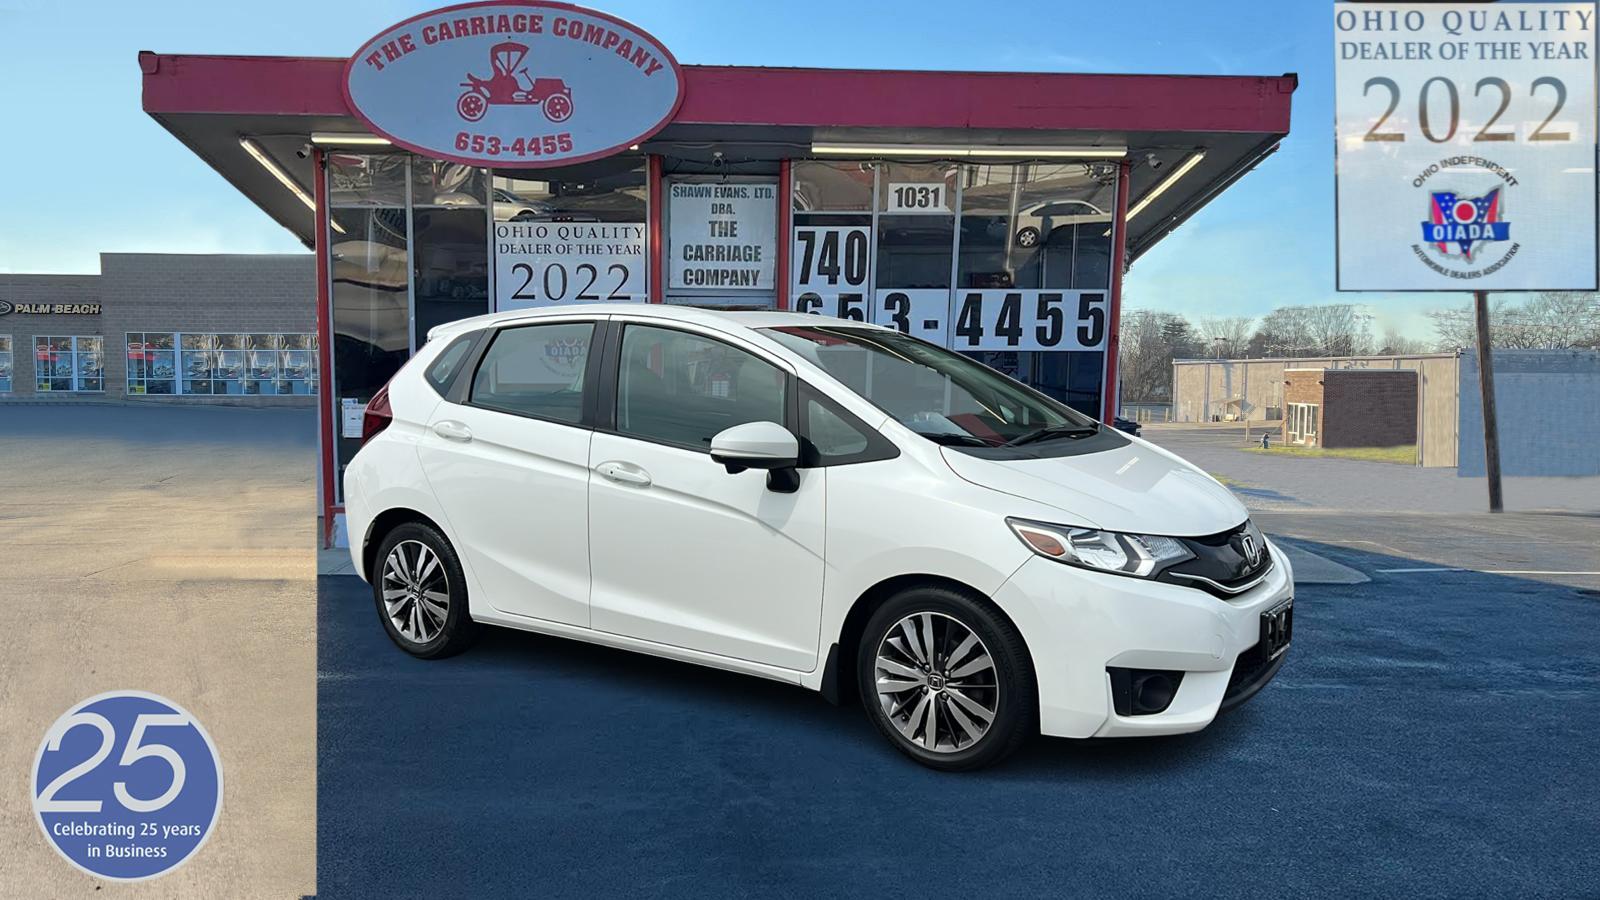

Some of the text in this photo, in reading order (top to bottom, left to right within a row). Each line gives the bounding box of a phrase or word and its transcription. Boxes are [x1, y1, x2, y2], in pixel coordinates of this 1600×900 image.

[1336, 10, 1593, 36] OHIO QUALITY
[366, 14, 664, 77] THE CARRIAGE COMPANY
[1340, 42, 1589, 60] DEALER OF THE YEAR
[1362, 76, 1571, 143] 2022
[455, 131, 573, 157] 653-4455
[1412, 155, 1519, 188] OHIO INDEPENDENT
[672, 186, 712, 199] SHAWN
[894, 186, 941, 208] 1031
[497, 226, 645, 241] OHIO QUALITY
[708, 220, 738, 238] THE
[1432, 224, 1495, 241] OIADA
[500, 243, 642, 255] DEALER OF THE YEAR
[683, 244, 762, 262] CARRIAGE
[797, 229, 868, 286] 740
[1411, 242, 1521, 279] AUTOMOBILE DEALERS ASSOCIATION
[511, 262, 632, 301] 2022
[683, 268, 760, 287] COMPANY
[14, 304, 51, 314] PALM
